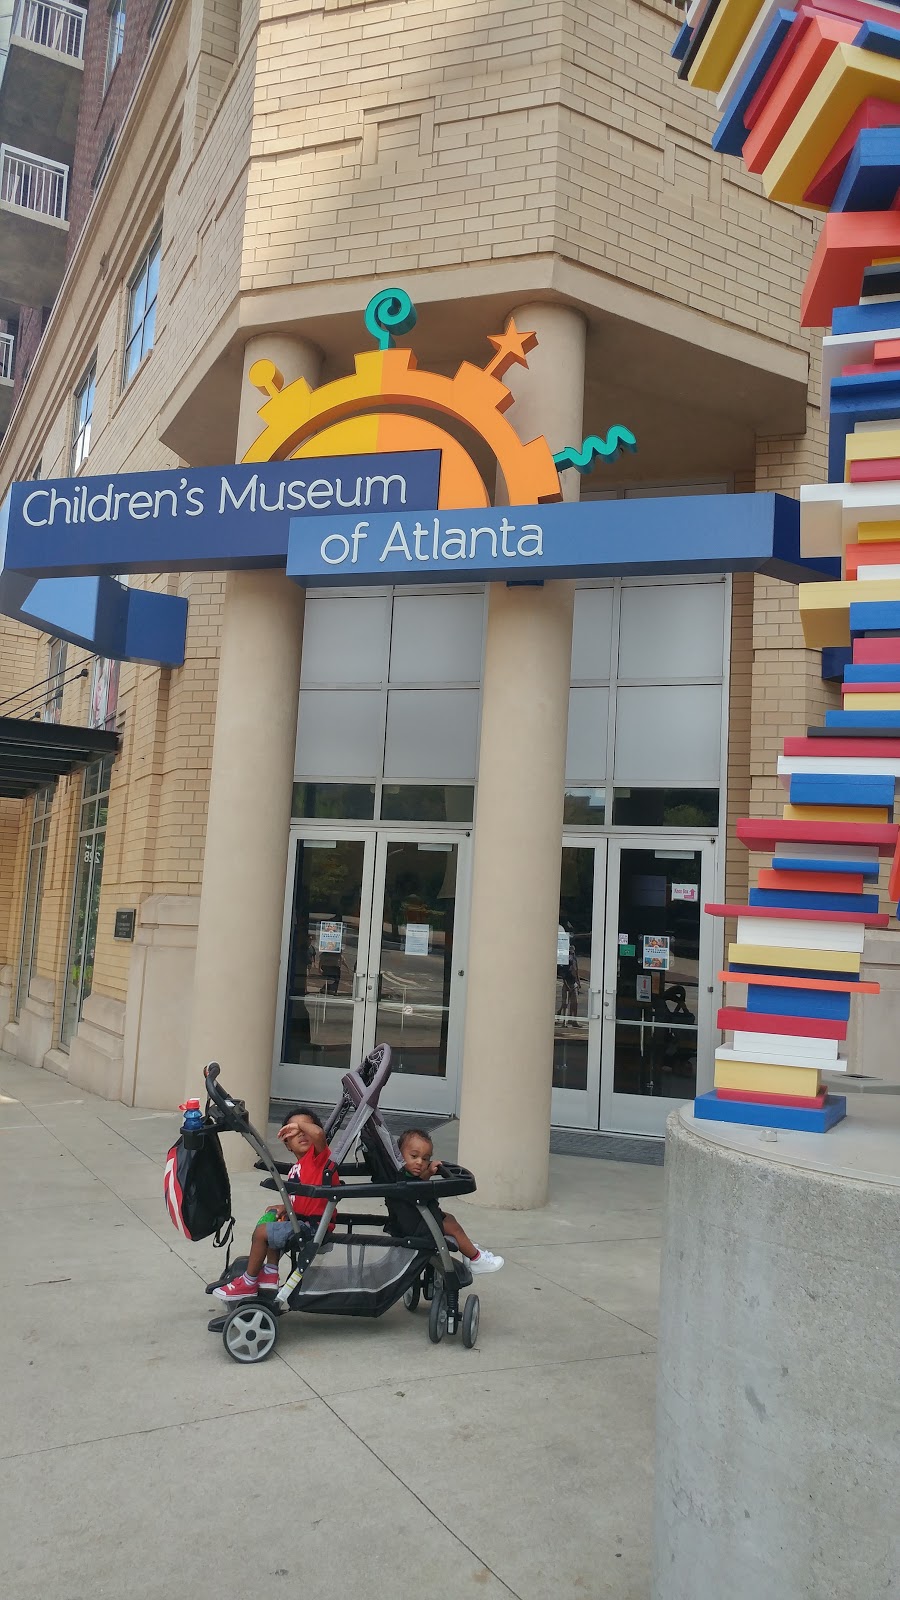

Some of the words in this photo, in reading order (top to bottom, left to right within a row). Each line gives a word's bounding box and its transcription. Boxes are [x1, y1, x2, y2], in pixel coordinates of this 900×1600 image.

[22, 478, 204, 527] Children's
[218, 474, 407, 514] Museum
[320, 521, 370, 564] of
[379, 517, 543, 562] Atlanta
